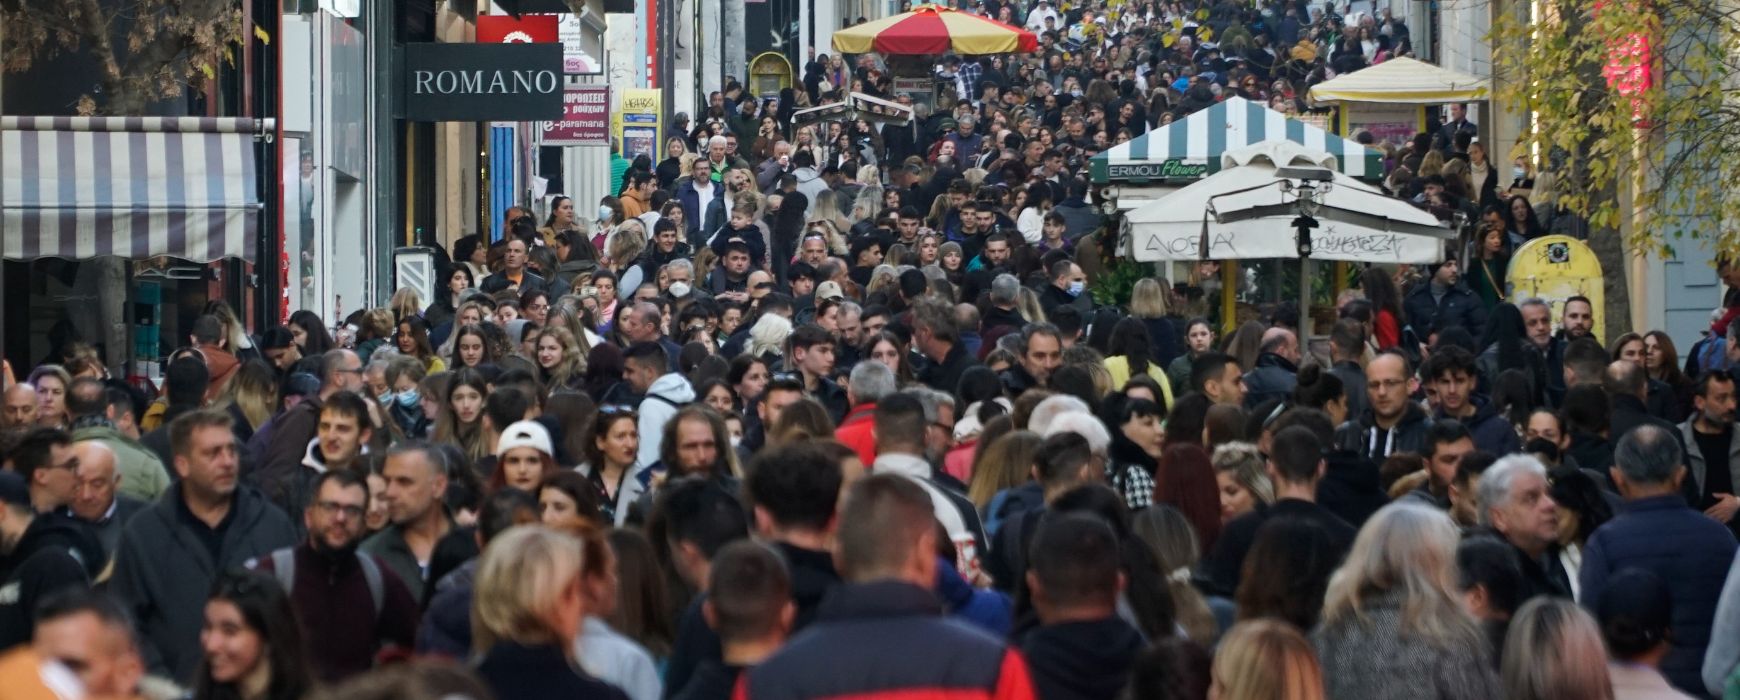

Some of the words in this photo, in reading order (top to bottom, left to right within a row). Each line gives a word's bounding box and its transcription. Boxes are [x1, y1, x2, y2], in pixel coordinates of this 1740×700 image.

[414, 70, 557, 94] ROMANO
[1109, 165, 1160, 177] ERMOU
[1161, 160, 1206, 176] Flower
